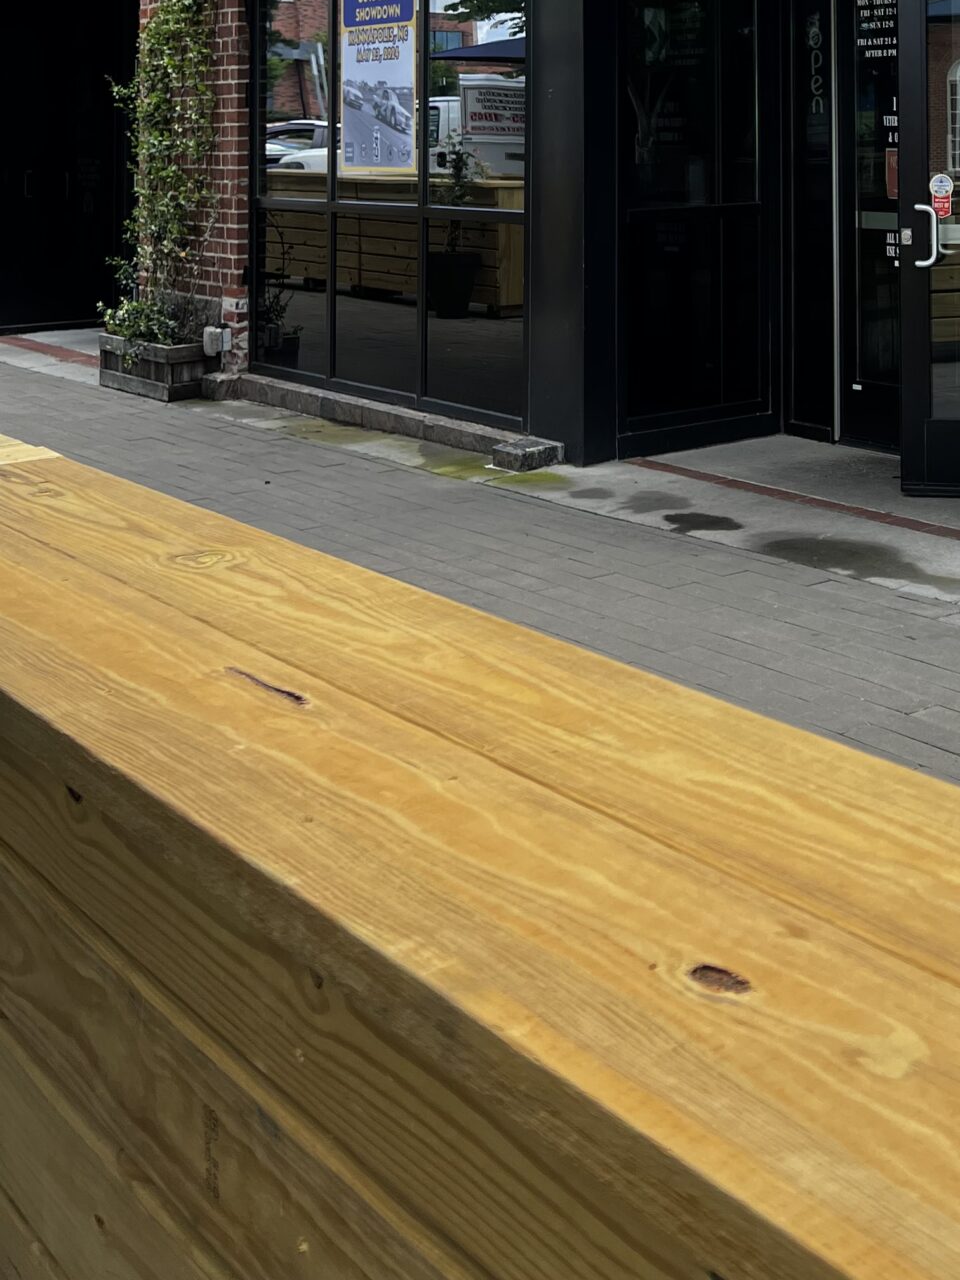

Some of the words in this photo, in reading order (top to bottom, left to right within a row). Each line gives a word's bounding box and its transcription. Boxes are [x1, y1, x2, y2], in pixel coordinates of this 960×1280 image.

[355, 4, 401, 22] SHOWDOWN
[860, 9, 870, 17] FRI
[873, 8, 884, 16] SAT
[869, 21, 881, 29] SUN
[397, 25, 408, 43] NC
[856, 38, 867, 46] FRI
[872, 37, 883, 45] SAT
[864, 49, 882, 58] AFTER
[887, 48, 897, 57] PM
